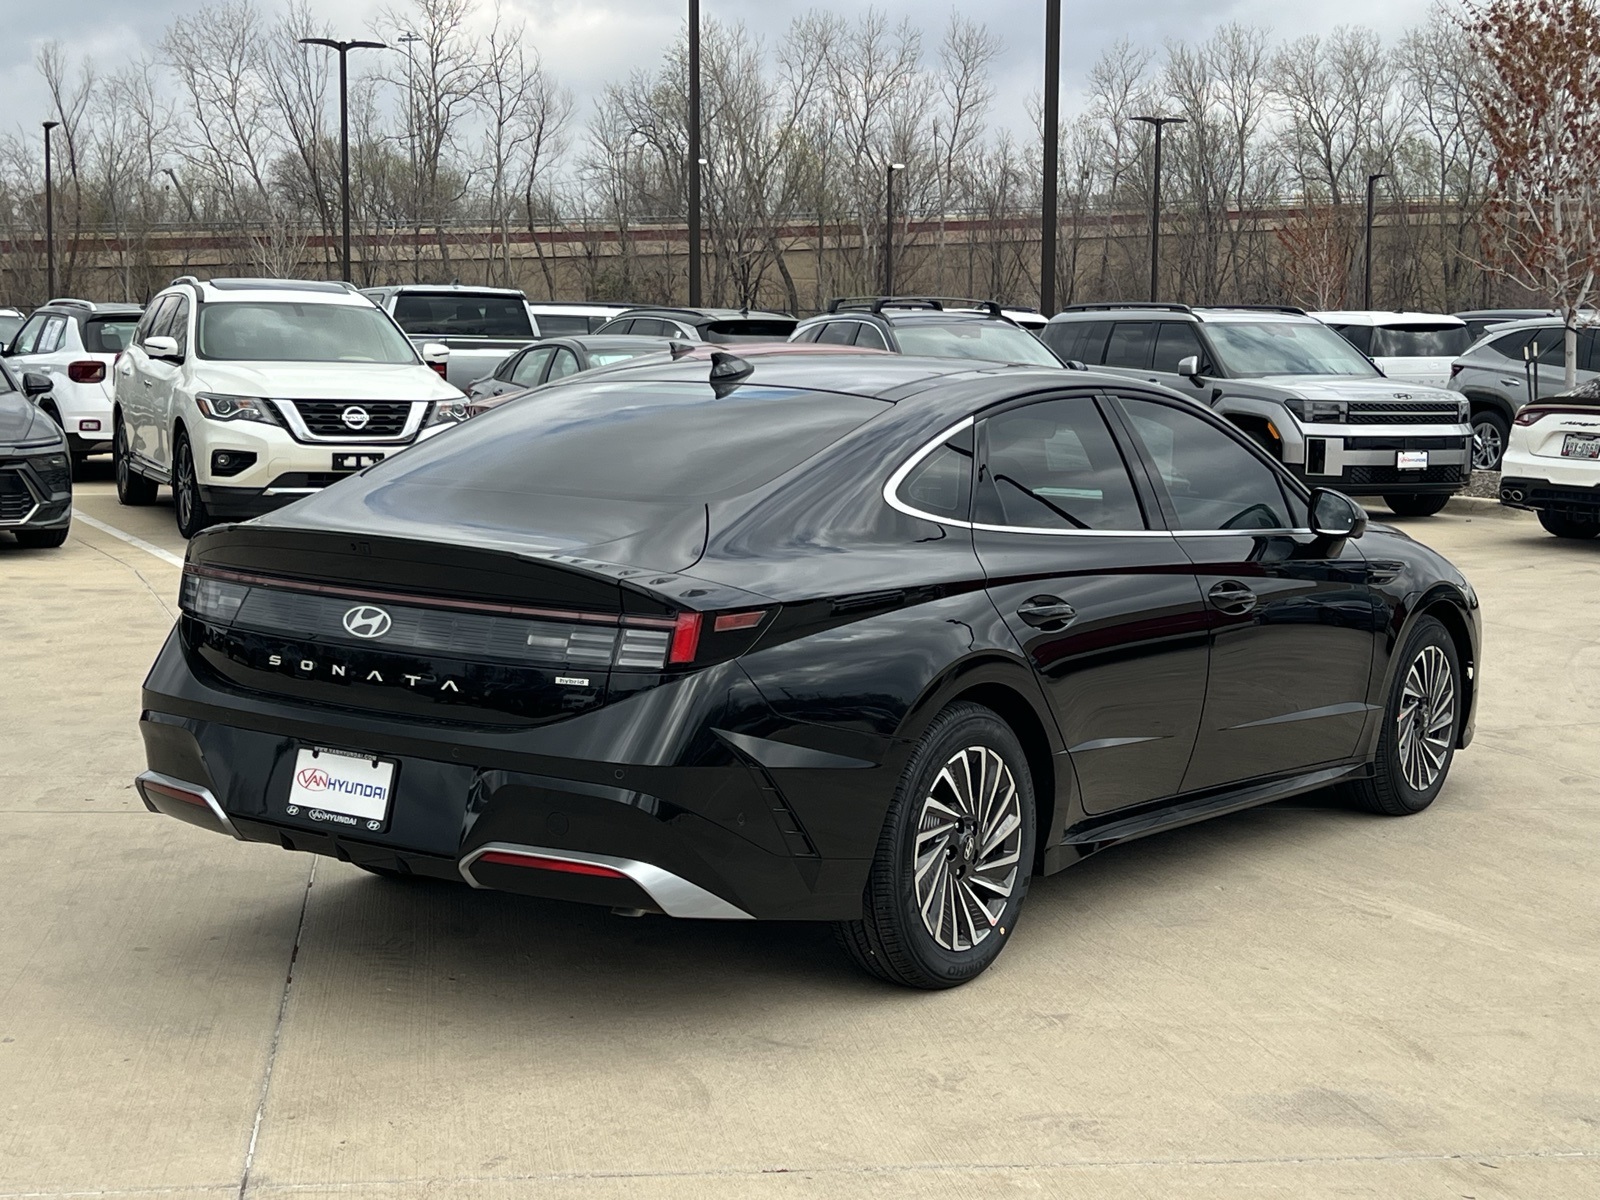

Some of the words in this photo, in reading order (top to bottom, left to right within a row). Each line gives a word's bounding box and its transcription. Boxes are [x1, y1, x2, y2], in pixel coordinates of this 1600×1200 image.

[269, 655, 459, 692] SONATA
[299, 768, 328, 789] VAN
[327, 778, 386, 800] HYUNDAI
[324, 814, 357, 825] HYUNDAI
